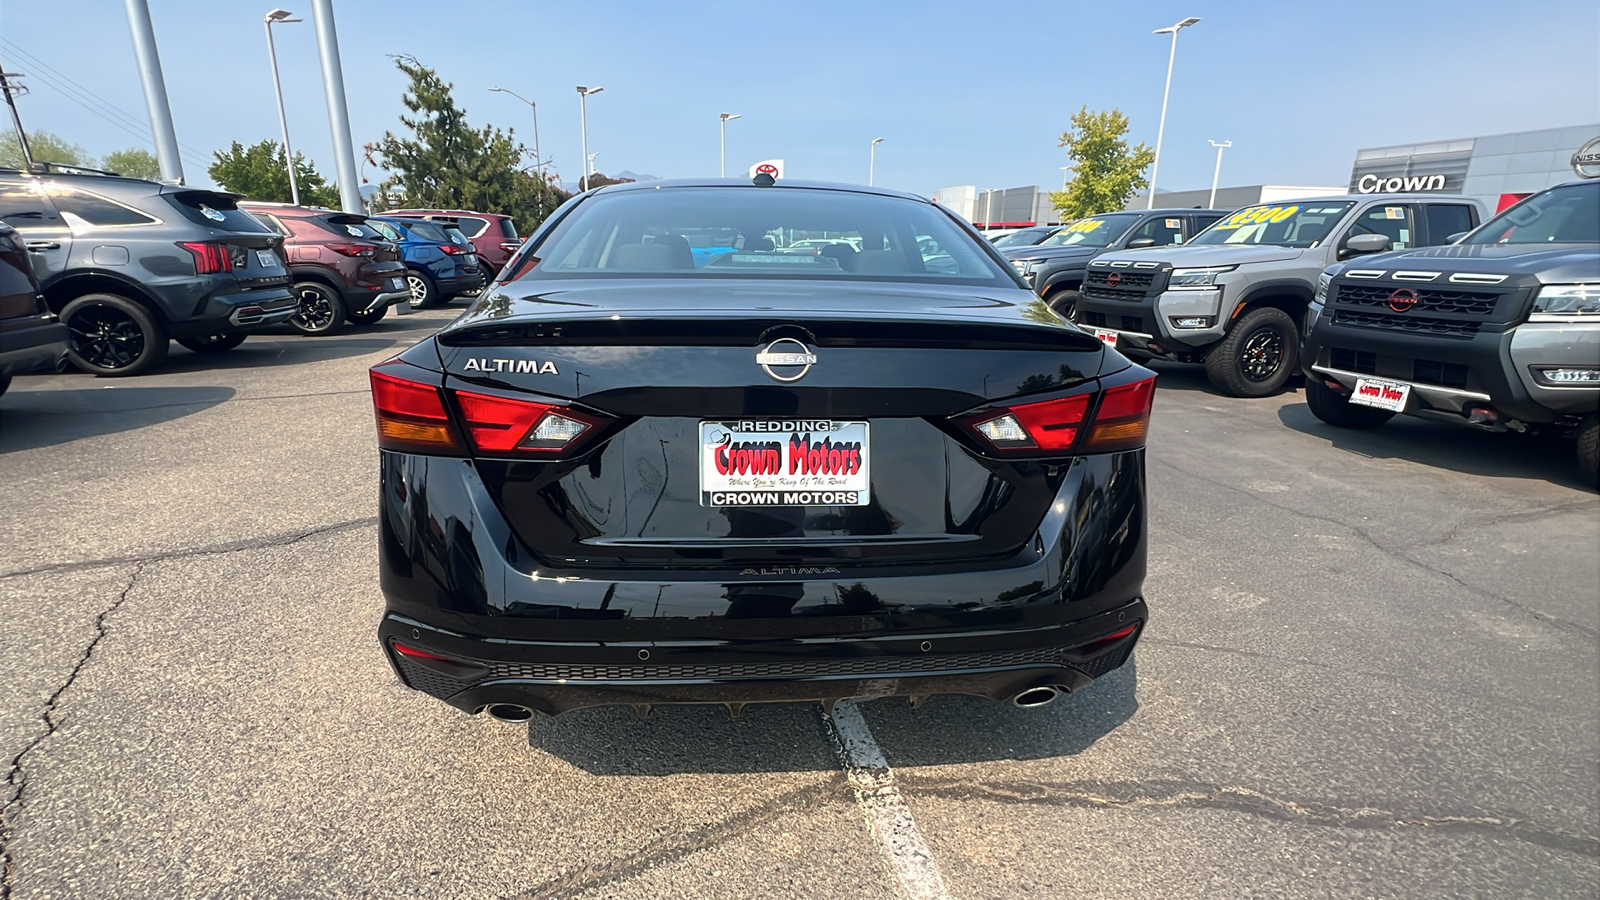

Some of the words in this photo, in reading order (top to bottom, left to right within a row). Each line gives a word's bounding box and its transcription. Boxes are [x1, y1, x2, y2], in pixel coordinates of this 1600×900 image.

[1358, 173, 1446, 194] Crown
[757, 354, 817, 364] NISSAN
[463, 358, 560, 375] ALTIMA
[741, 420, 830, 432] REDDING
[714, 435, 782, 476] Crown
[789, 433, 863, 476] Motors
[728, 477, 751, 486] Where
[779, 477, 797, 488] King
[799, 477, 811, 488] Of
[811, 476, 825, 486] The
[827, 477, 847, 486] Road
[712, 492, 779, 505] CROWN
[783, 492, 858, 505] MOTORS
[739, 565, 841, 576] ALTIMA
